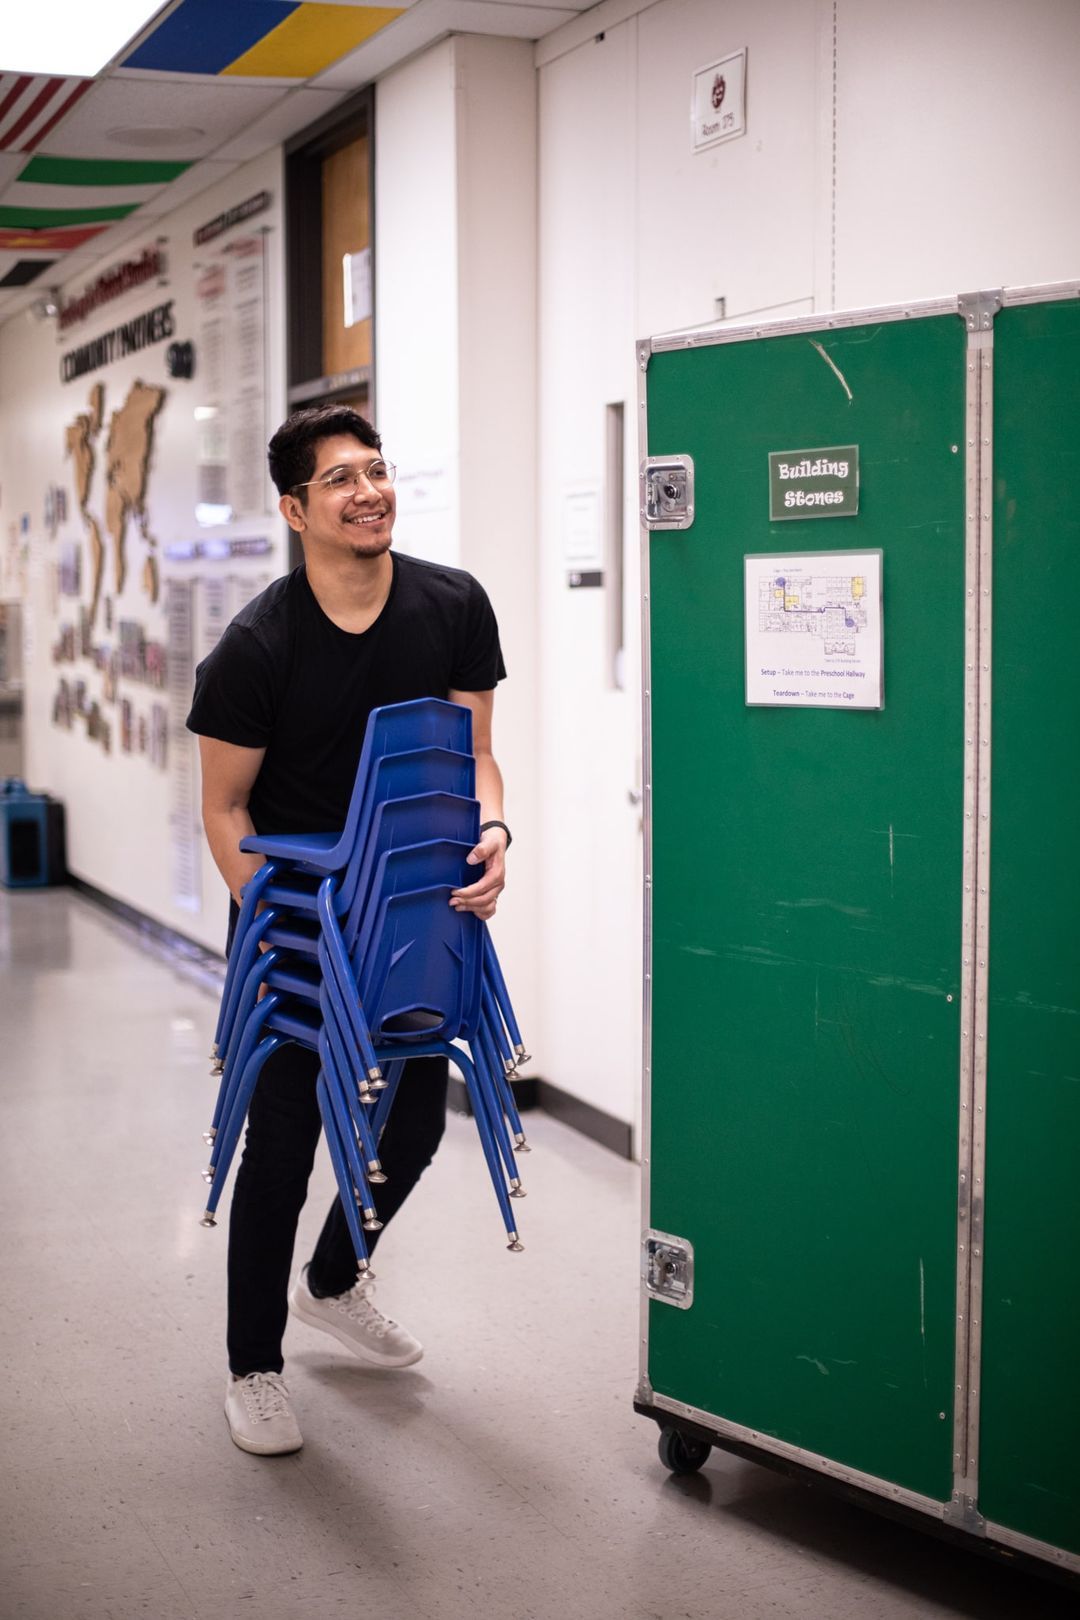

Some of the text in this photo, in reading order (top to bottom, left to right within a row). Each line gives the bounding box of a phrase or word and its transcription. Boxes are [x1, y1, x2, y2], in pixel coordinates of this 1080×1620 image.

[116, 300, 175, 359] PARTNERS
[778, 459, 849, 479] Building
[784, 490, 844, 507] Stones
[846, 670, 865, 678] Hallway
[843, 692, 855, 700] Cage
